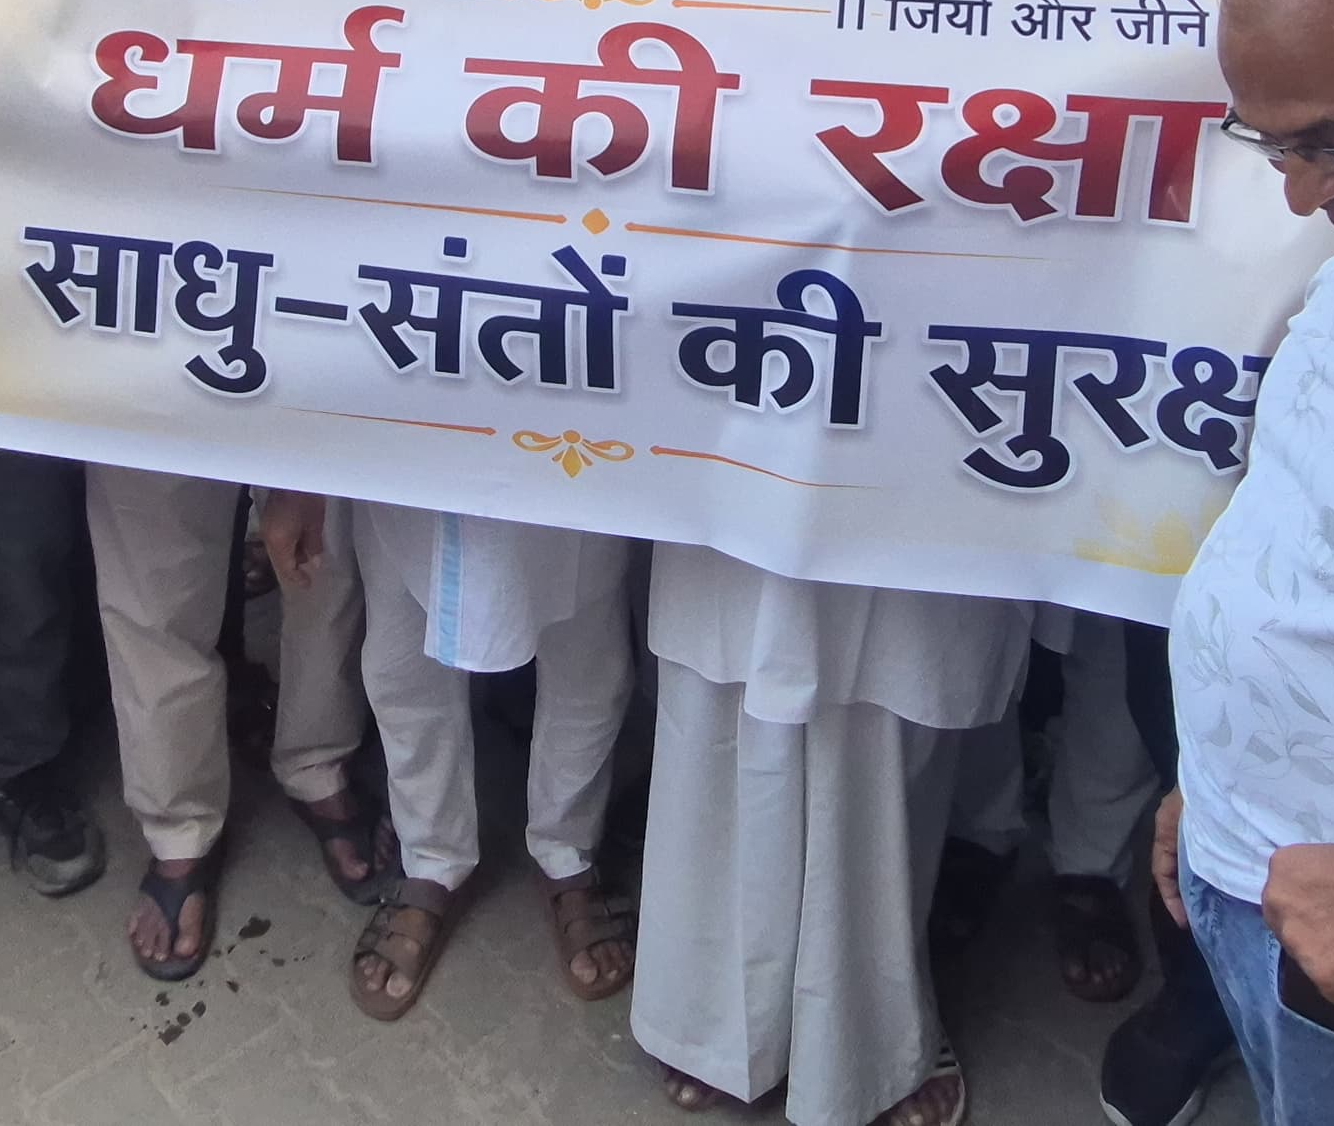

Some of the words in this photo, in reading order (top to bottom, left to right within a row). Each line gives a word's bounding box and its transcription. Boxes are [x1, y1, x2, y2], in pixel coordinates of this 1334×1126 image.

[90, 5, 405, 164] धर्म
[464, 21, 741, 191] की
[810, 79, 1228, 223] रक्षा
[671, 268, 882, 425] की
[928, 324, 1272, 488] सुरक्ष
